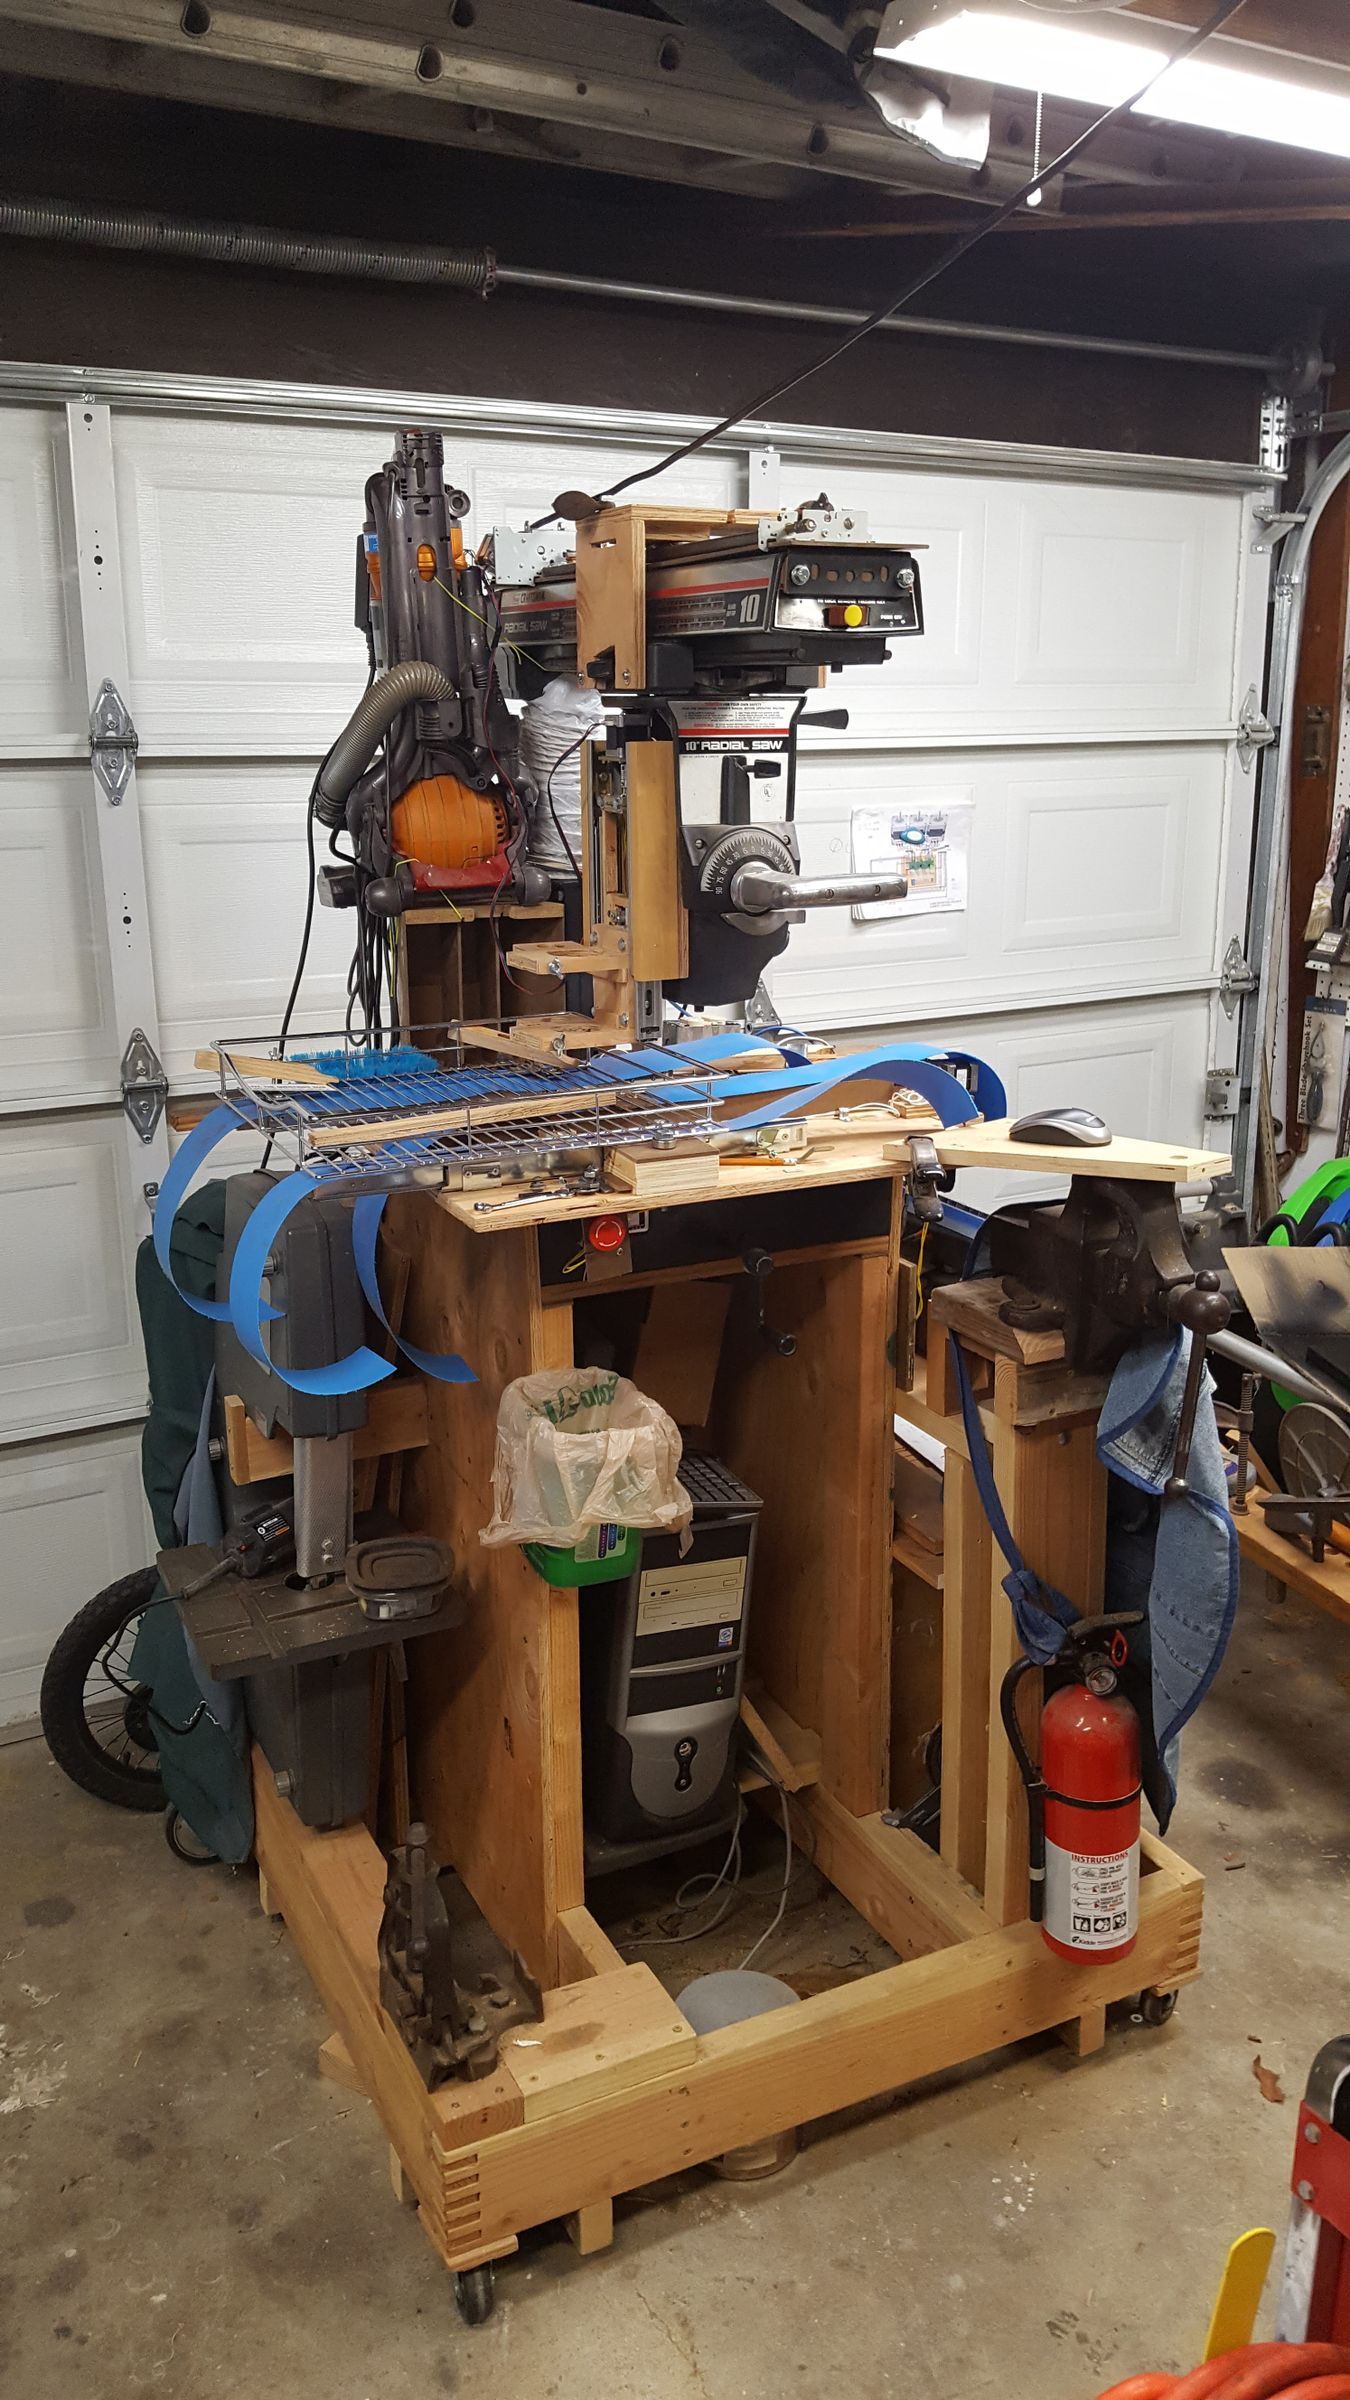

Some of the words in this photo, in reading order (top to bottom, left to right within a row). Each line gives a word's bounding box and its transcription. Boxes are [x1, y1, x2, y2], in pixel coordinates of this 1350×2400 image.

[739, 594, 761, 623] 10
[701, 741, 750, 751] RADIAL
[751, 740, 783, 751] SAW
[715, 886, 723, 895] 90
[1298, 1099, 1306, 1121] Three
[1304, 1015, 1312, 1029] Set
[1071, 1849, 1129, 1864] INSTRUCTIONS
